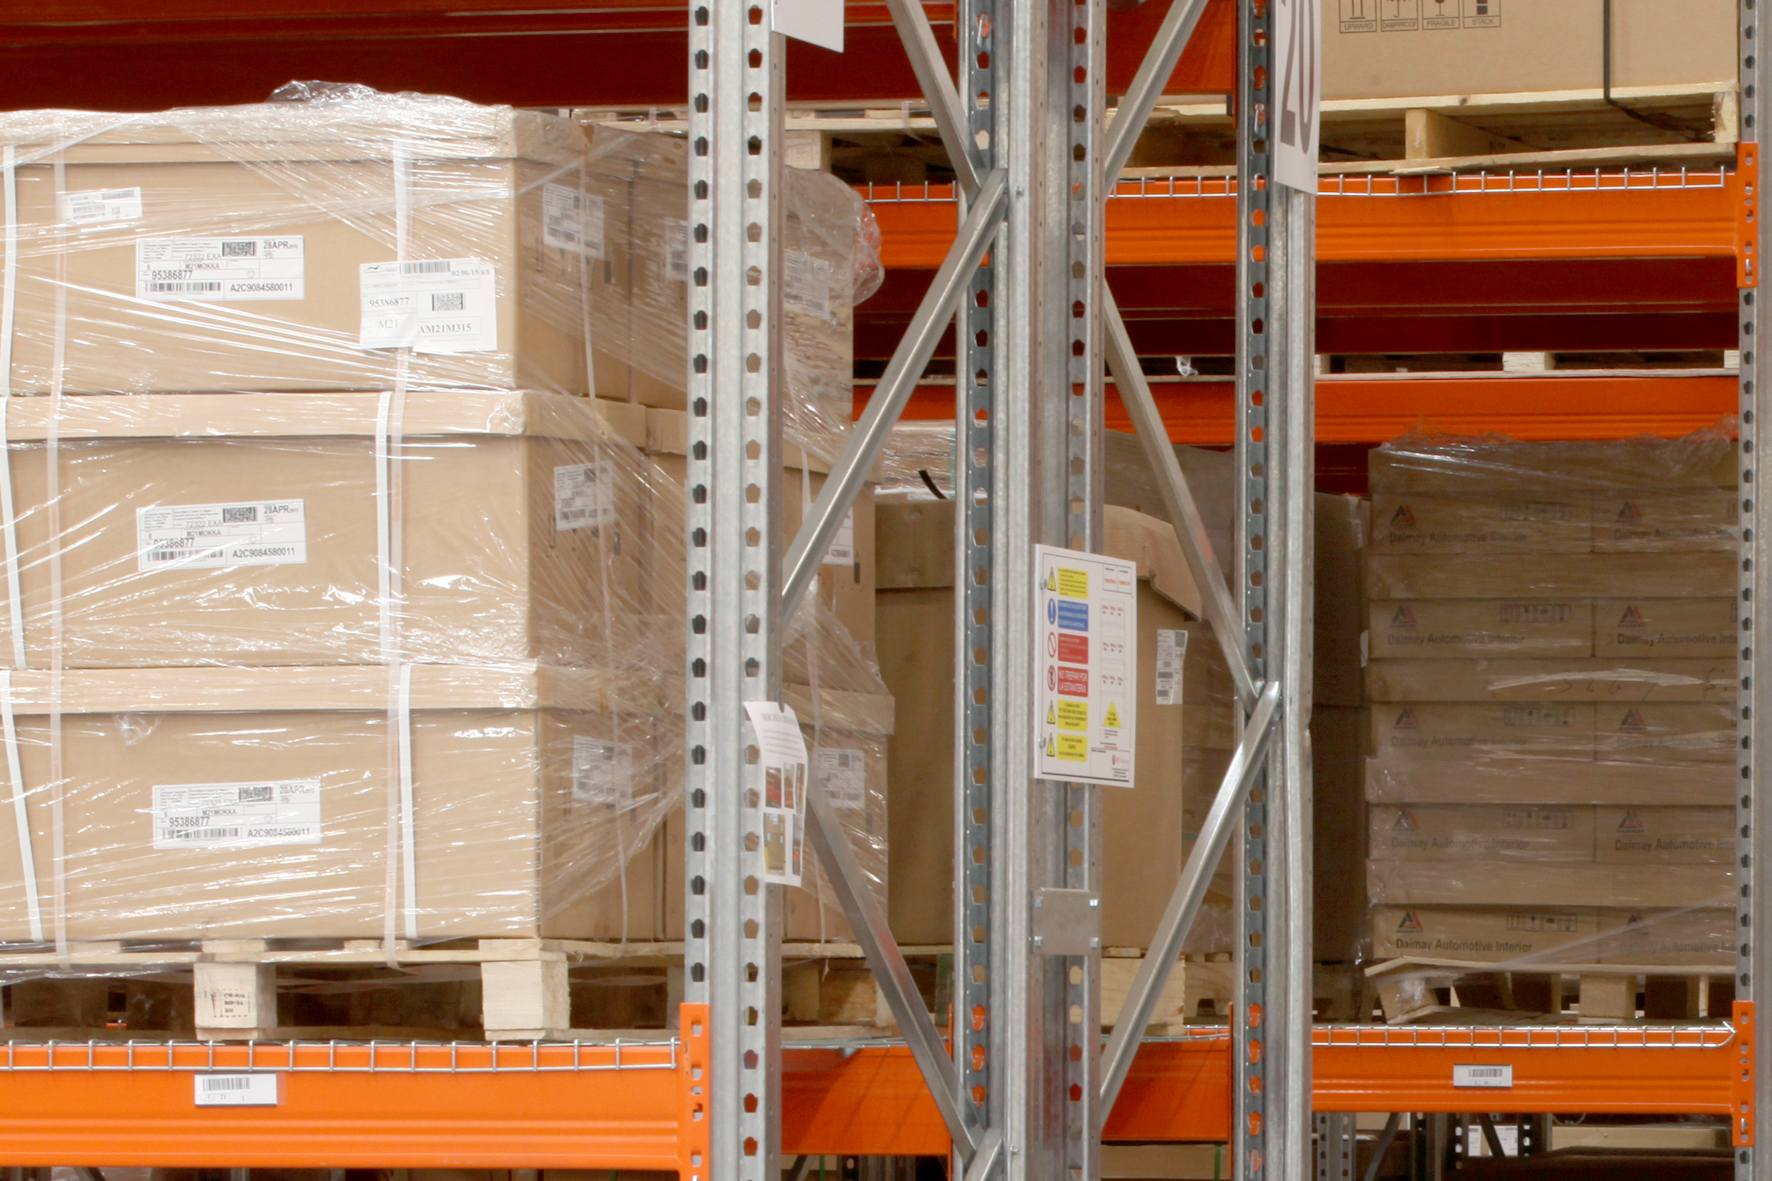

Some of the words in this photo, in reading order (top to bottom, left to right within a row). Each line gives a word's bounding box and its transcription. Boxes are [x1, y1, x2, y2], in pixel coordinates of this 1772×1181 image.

[1344, 21, 1374, 30] UPWARD
[1382, 20, 1417, 29] DAMPPROOF
[1427, 19, 1456, 27] FRAGILE
[1472, 17, 1494, 25] STACK
[1279, 0, 1315, 156] 20
[151, 269, 193, 280] 95386877
[229, 282, 293, 292] A2C9084580011
[369, 297, 410, 307] 95386877
[379, 319, 399, 329] M21
[419, 323, 472, 334] AM21M315
[1389, 532, 1428, 546] Daimay
[232, 547, 295, 558] A2C9084580011
[1387, 634, 1425, 646] Daimay
[1658, 633, 1717, 646] Automotive
[1391, 736, 1429, 748] Daimay
[168, 817, 210, 827] 95386877
[1391, 837, 1429, 851] Daimay
[1614, 839, 1653, 852] Daimay
[1655, 838, 1714, 851] Automotive
[1396, 938, 1433, 953] Daimay
[1435, 939, 1493, 952] Automotive
[1495, 941, 1533, 953] Interior
